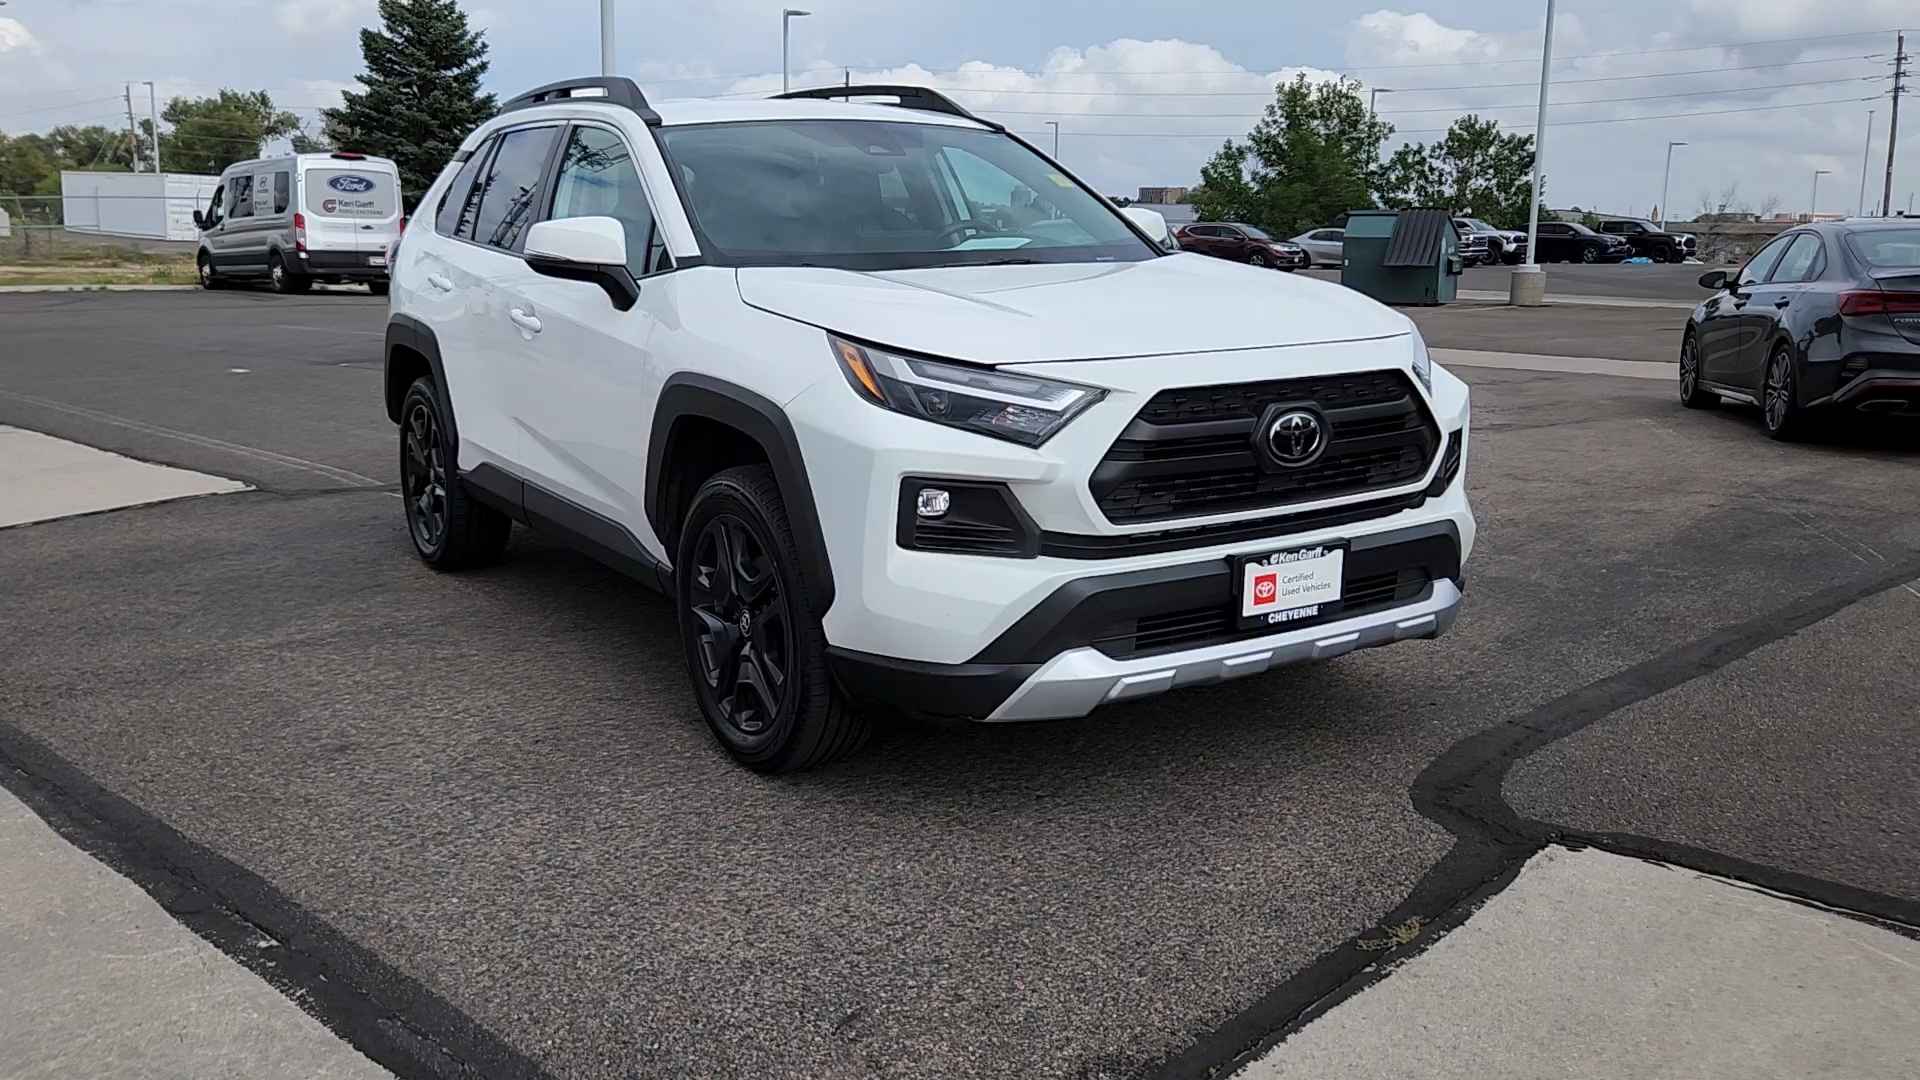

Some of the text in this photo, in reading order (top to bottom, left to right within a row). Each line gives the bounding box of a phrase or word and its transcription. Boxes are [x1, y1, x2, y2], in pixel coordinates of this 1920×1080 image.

[337, 177, 367, 190] Ford
[338, 199, 354, 208] Ken
[1279, 546, 1323, 564] Ken Garff
[1282, 571, 1314, 584] Certified
[1281, 581, 1332, 597] Used Vehicles
[1268, 605, 1319, 624] CHEYENNE
